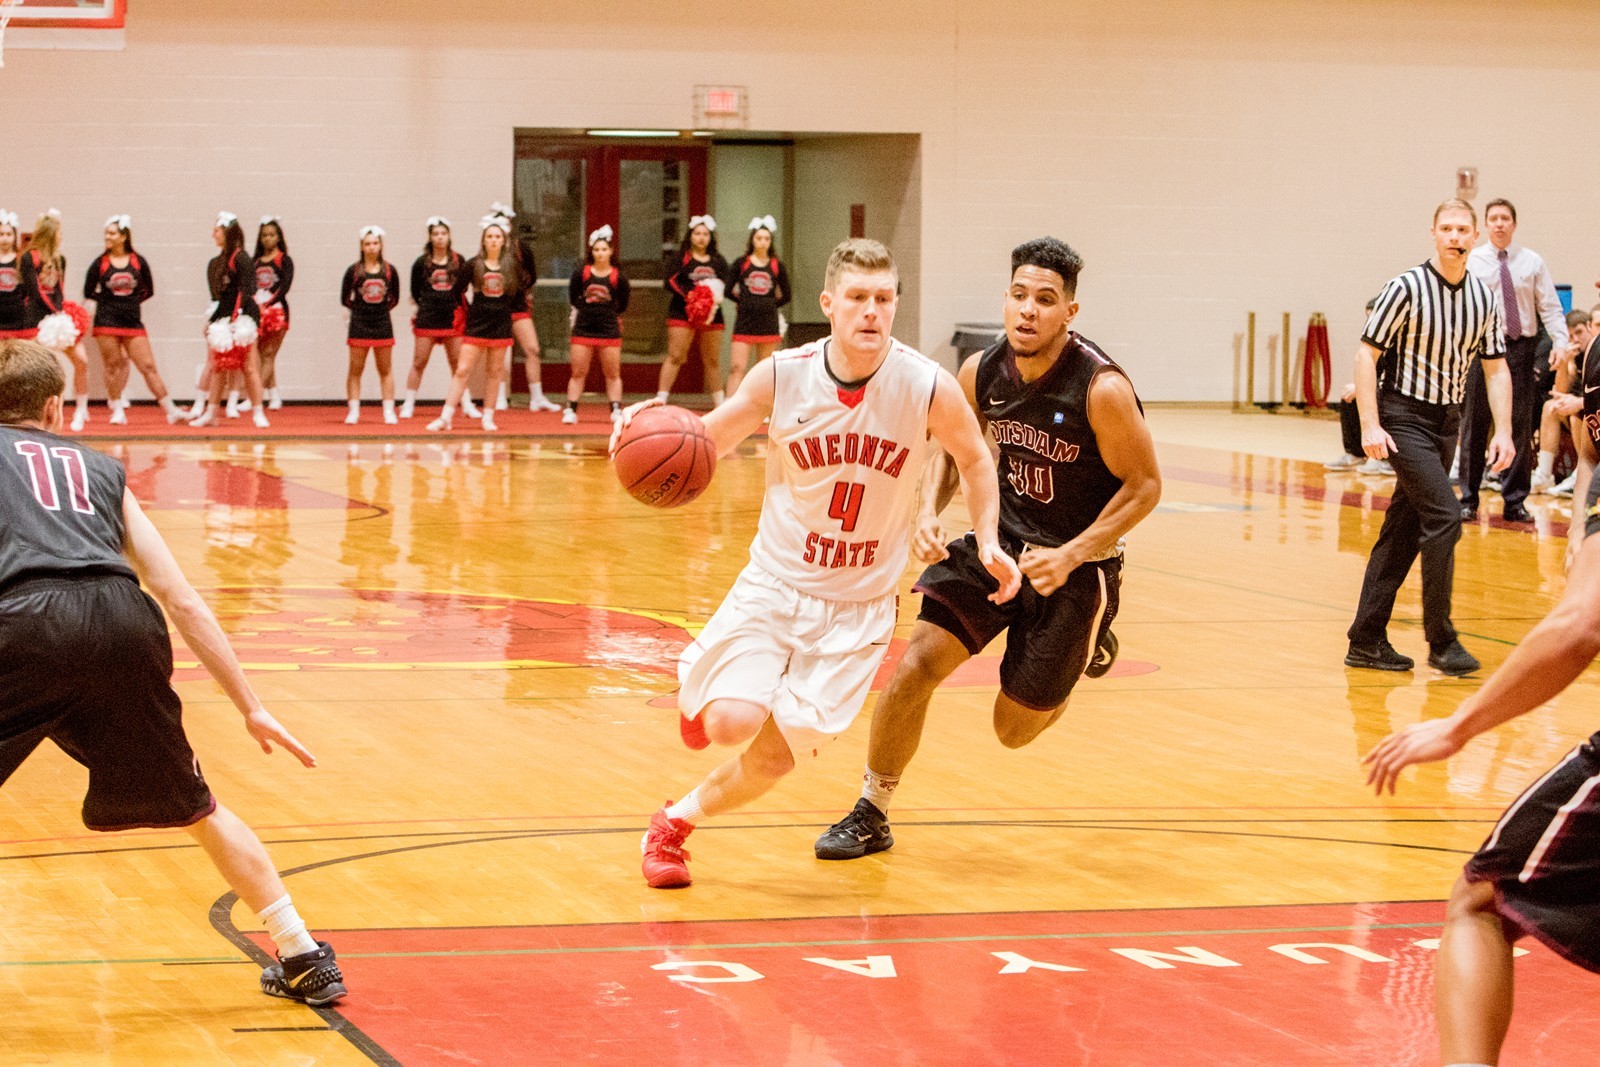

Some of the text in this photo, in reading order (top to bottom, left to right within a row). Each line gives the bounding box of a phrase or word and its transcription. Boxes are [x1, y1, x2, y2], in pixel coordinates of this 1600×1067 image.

[14, 440, 95, 516] 11
[788, 432, 910, 479] ONEONTA
[828, 481, 865, 532] 4
[803, 531, 880, 569] STATE
